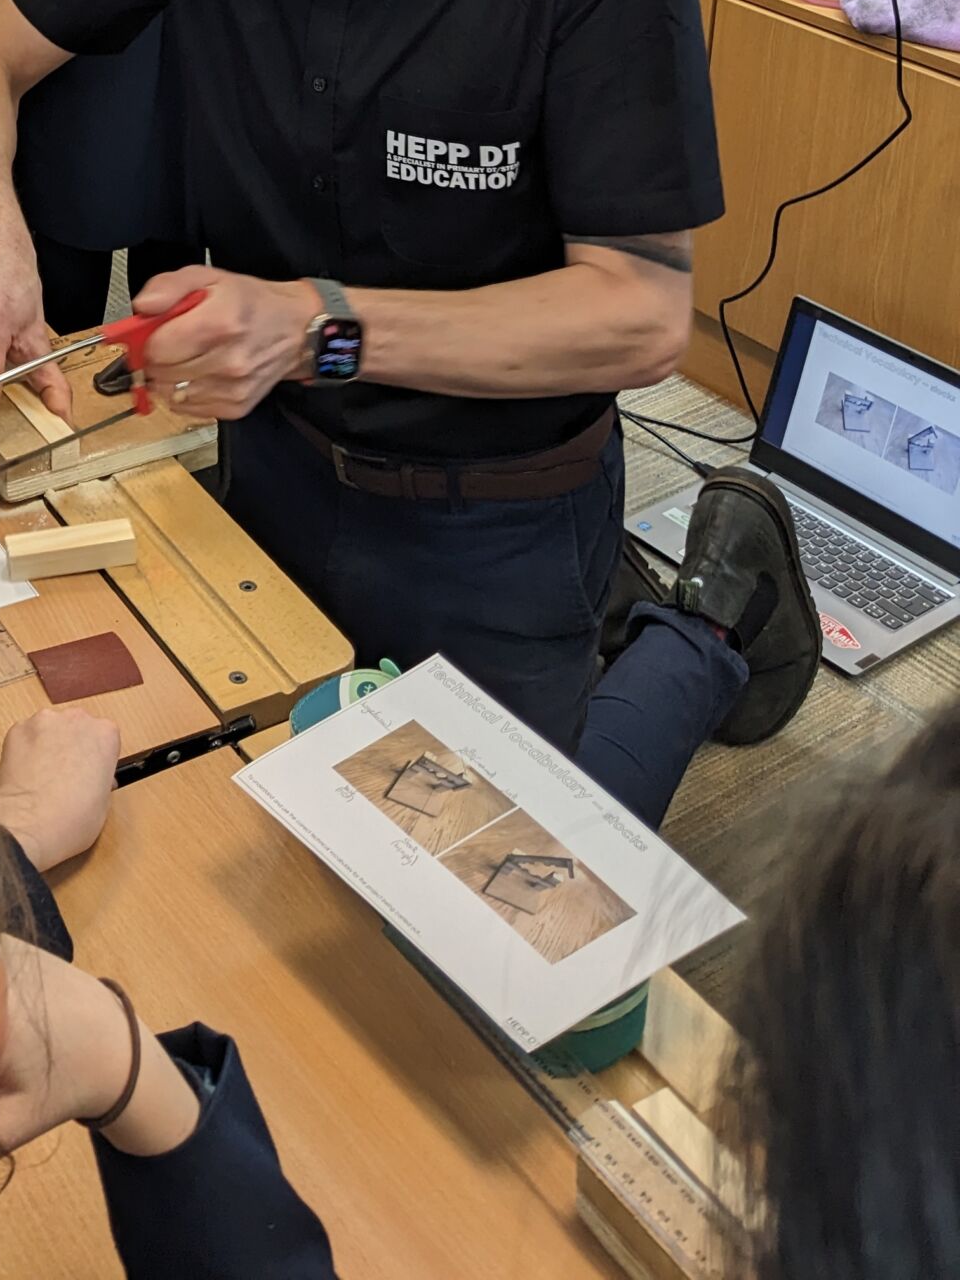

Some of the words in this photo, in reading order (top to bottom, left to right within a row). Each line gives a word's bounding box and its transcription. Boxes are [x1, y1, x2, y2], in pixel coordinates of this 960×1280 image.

[386, 129, 470, 165] HEPP
[479, 141, 521, 168] DT
[393, 155, 435, 169] SPECIALIST
[447, 164, 485, 174] PRIMARY
[386, 159, 518, 190] EDUCATION
[427, 662, 503, 725] Technical
[499, 720, 593, 800] Vocabulary
[603, 812, 649, 853] stocks
